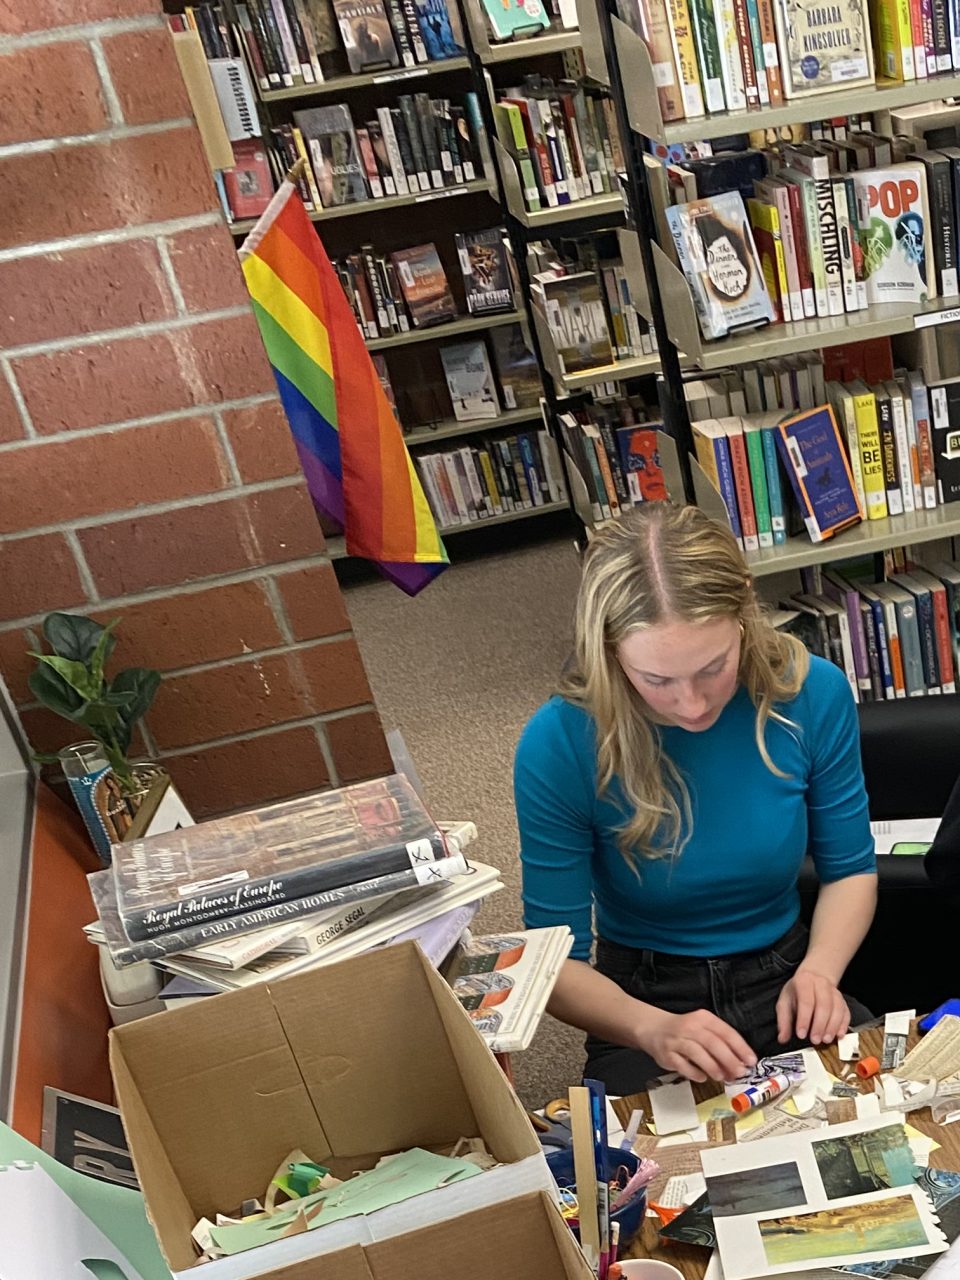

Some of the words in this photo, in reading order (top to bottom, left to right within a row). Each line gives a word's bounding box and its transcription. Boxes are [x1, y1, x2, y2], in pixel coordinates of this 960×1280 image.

[806, 6, 842, 27] BARBARA
[803, 28, 851, 52] KINGSOLVER
[868, 179, 919, 218] POP
[815, 179, 840, 275] MISCHLING
[708, 249, 738, 266] Dinner
[857, 399, 873, 408] LAKE
[860, 431, 877, 439] THERE
[862, 440, 878, 449] WILL
[863, 450, 880, 464] BE
[864, 465, 882, 476] LIES
[143, 903, 183, 925] Royal
[184, 893, 227, 916] Palaces
[228, 889, 243, 907] of
[243, 880, 283, 903] Europe
[201, 918, 239, 938] EARLY
[241, 901, 300, 928] AMERICAN
[302, 889, 345, 909] HOMES
[147, 921, 171, 934] HUGH
[316, 921, 344, 946] GEORGE
[342, 906, 366, 926] SEGAL
